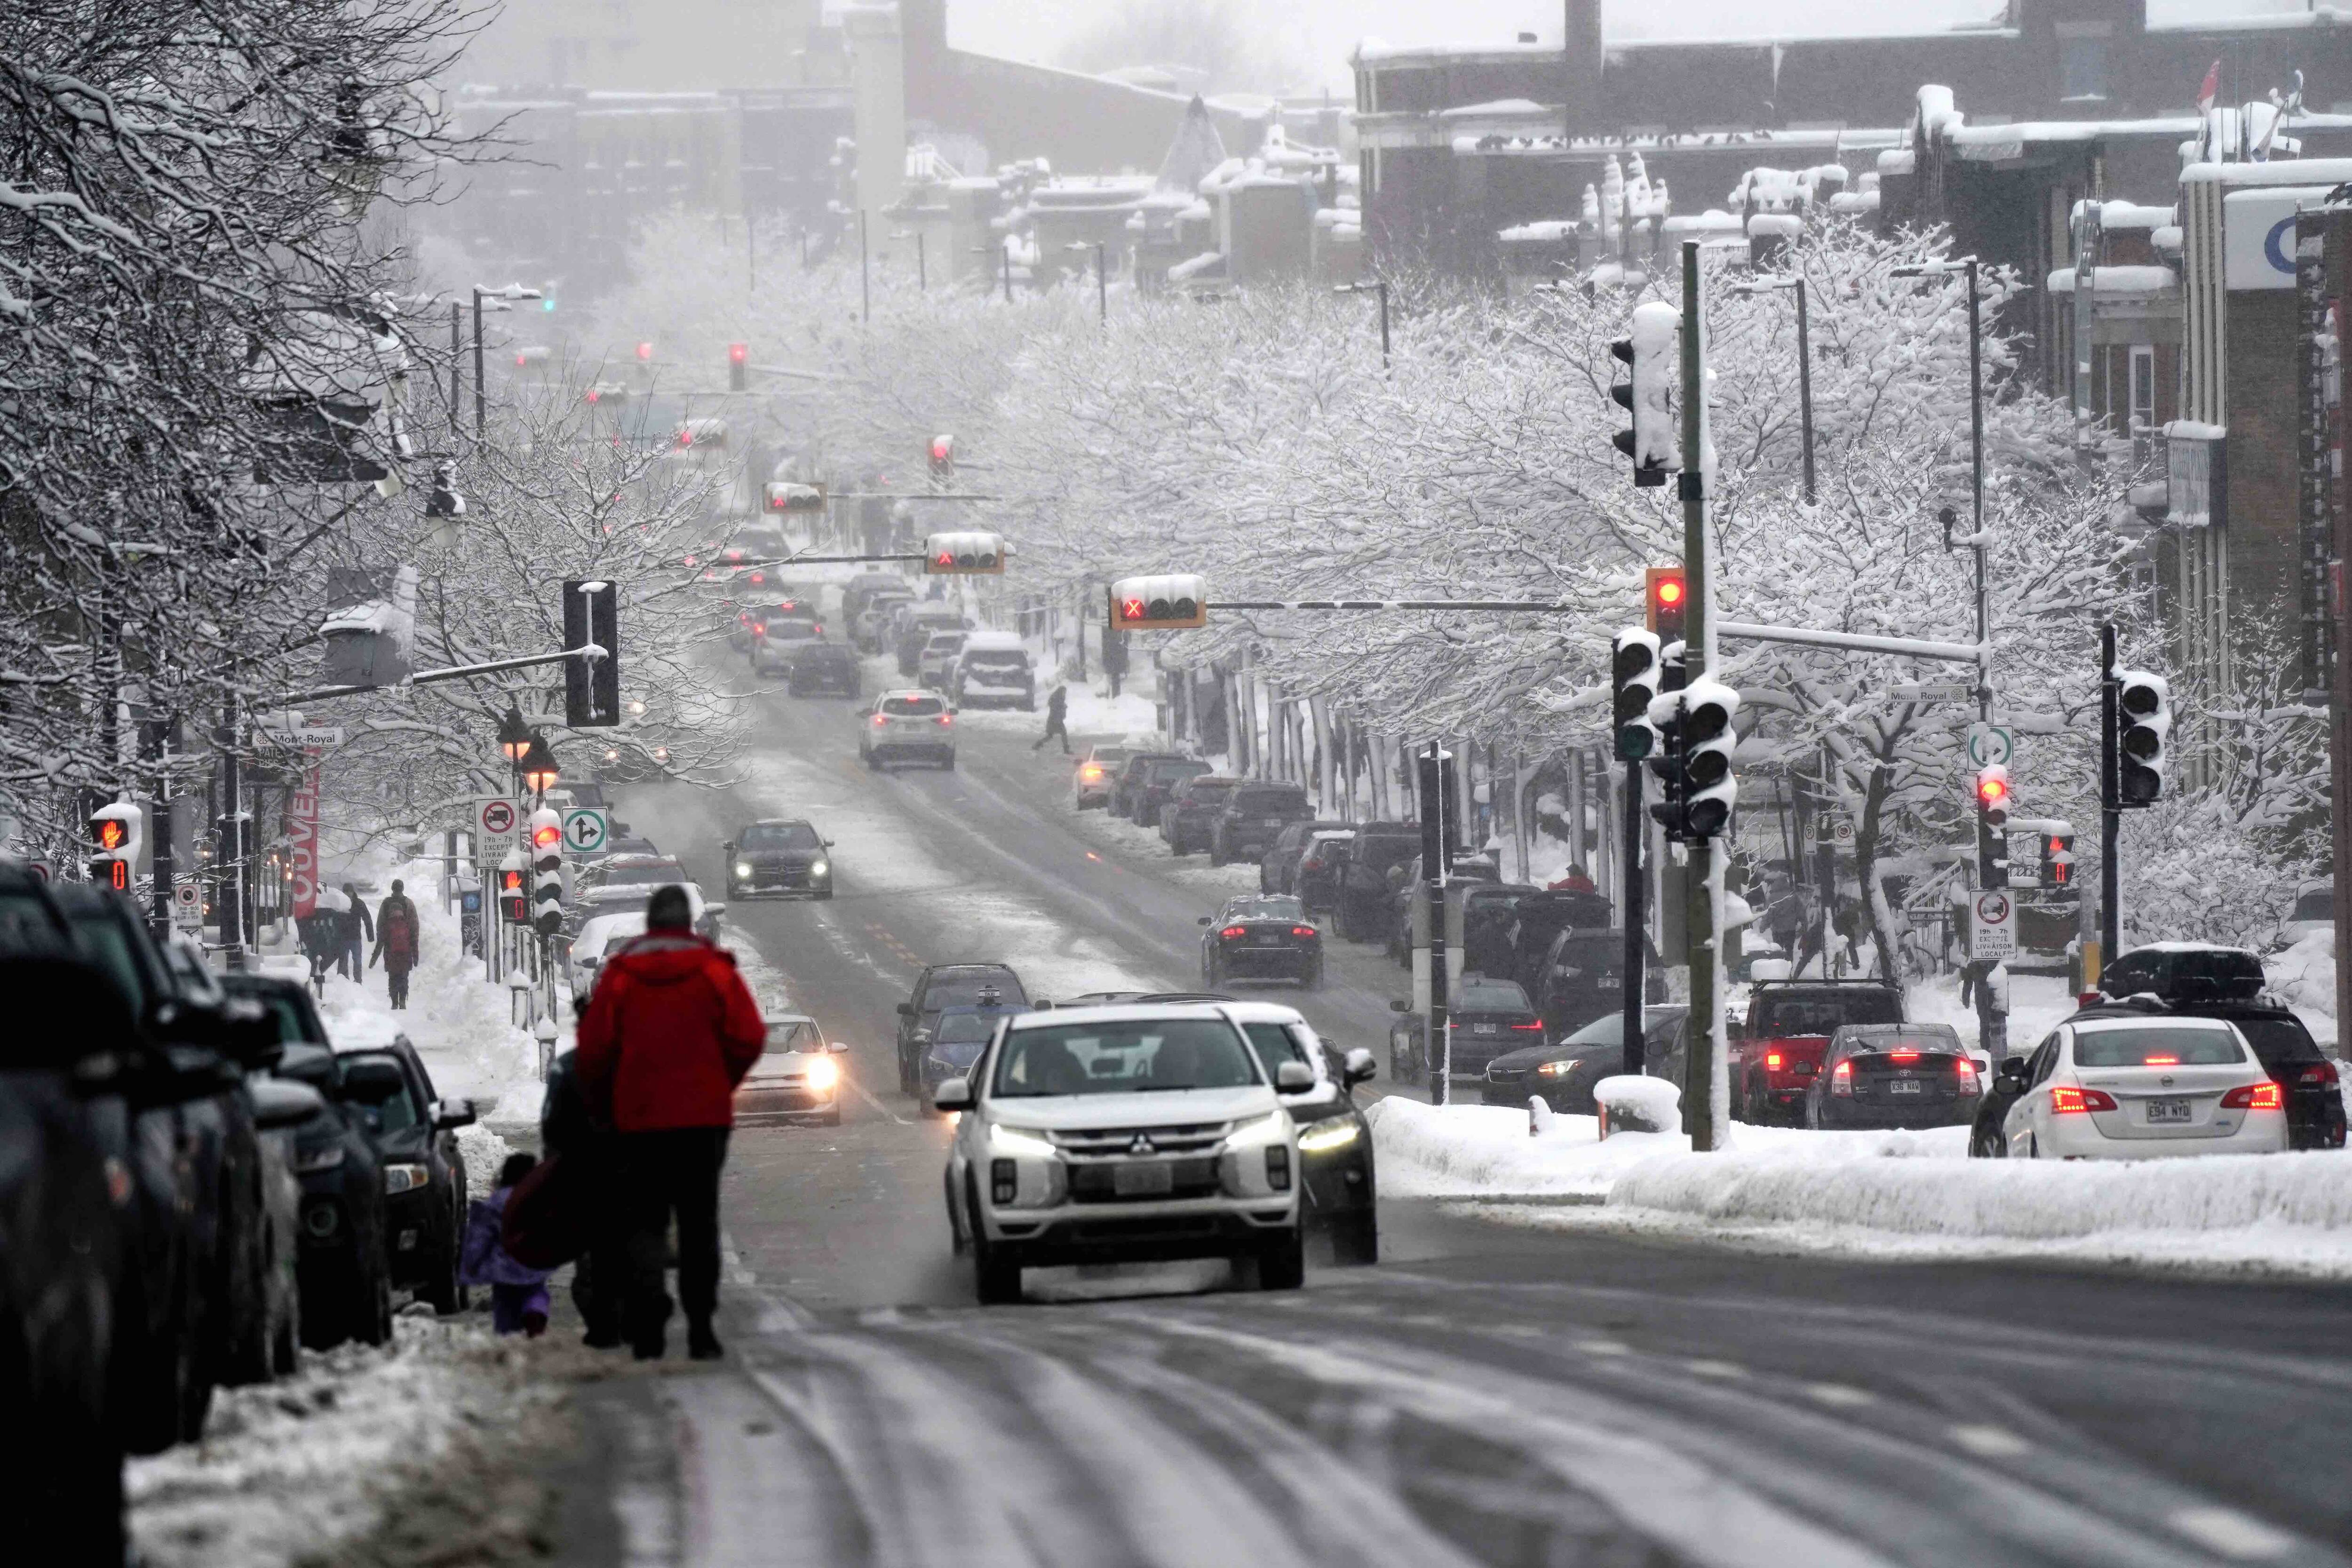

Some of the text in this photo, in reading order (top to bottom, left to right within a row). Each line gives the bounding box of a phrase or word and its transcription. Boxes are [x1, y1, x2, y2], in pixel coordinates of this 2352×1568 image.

[274, 734, 335, 745] Mont-Royal
[113, 861, 125, 890] 0
[515, 899, 524, 918] 0
